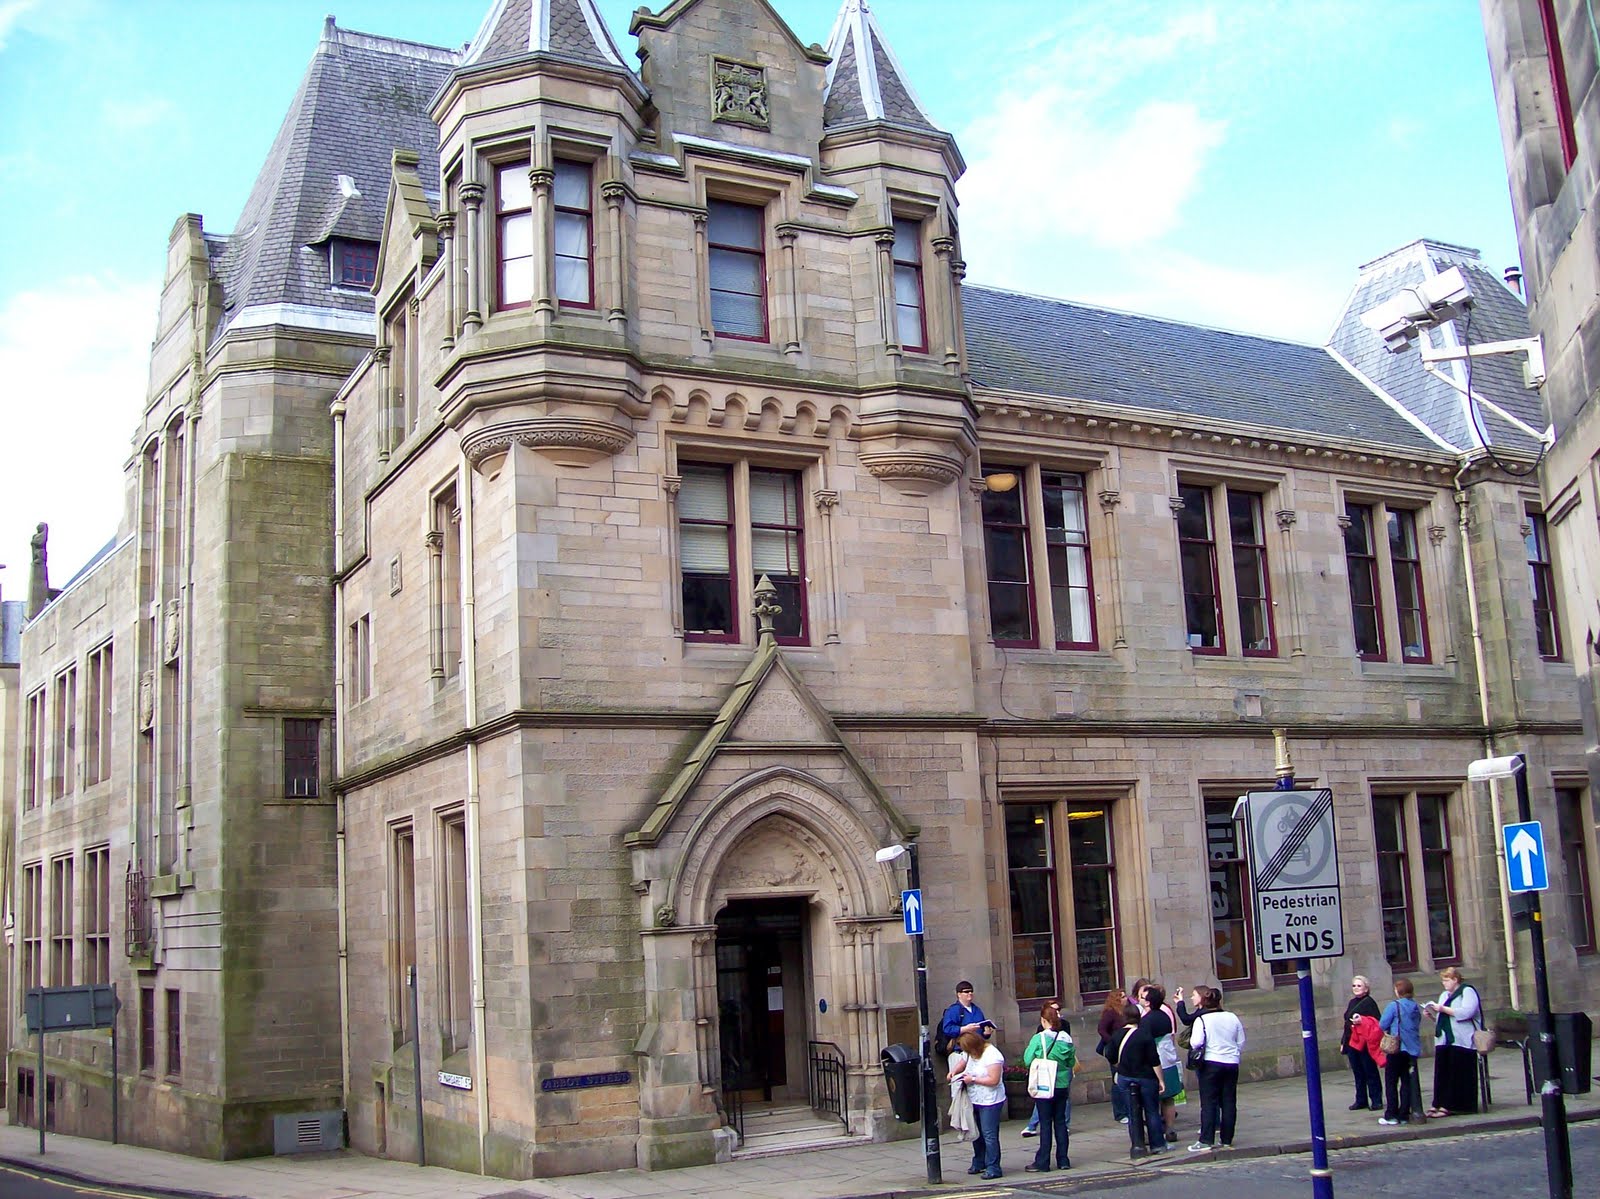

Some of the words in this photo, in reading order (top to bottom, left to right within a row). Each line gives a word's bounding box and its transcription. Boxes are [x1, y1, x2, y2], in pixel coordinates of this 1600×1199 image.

[1263, 893, 1336, 910] Pedestrian
[1285, 913, 1318, 927] Zone
[1270, 930, 1335, 955] ENDS
[1079, 954, 1107, 964] share
[544, 1078, 580, 1089] ABBOT
[587, 1073, 628, 1084] STREET
